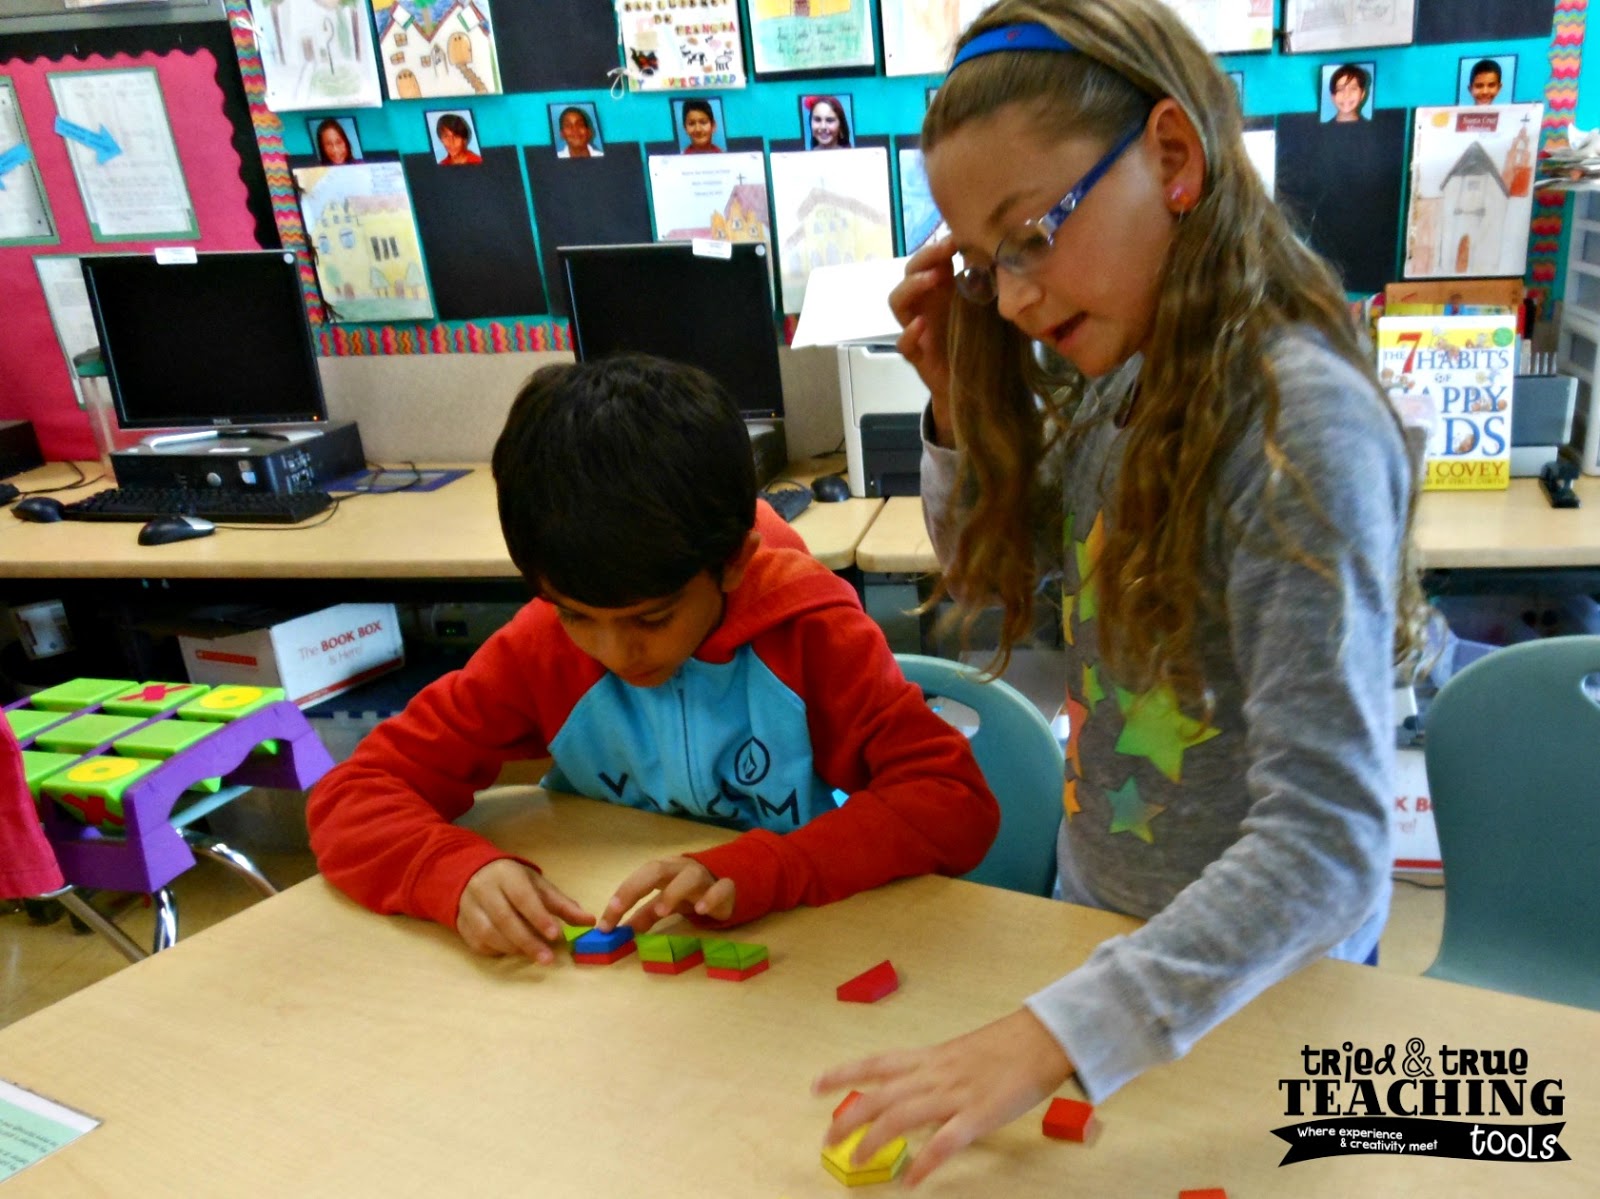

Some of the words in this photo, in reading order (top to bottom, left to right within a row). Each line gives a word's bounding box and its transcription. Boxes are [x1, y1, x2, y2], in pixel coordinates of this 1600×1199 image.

[1384, 351, 1405, 361] THE
[1396, 332, 1422, 374] 7
[1417, 349, 1509, 370] HABITS
[1402, 385, 1507, 414] PPY
[1435, 462, 1506, 478] COVEY
[320, 631, 355, 652] BOOK
[357, 620, 383, 638] BOX
